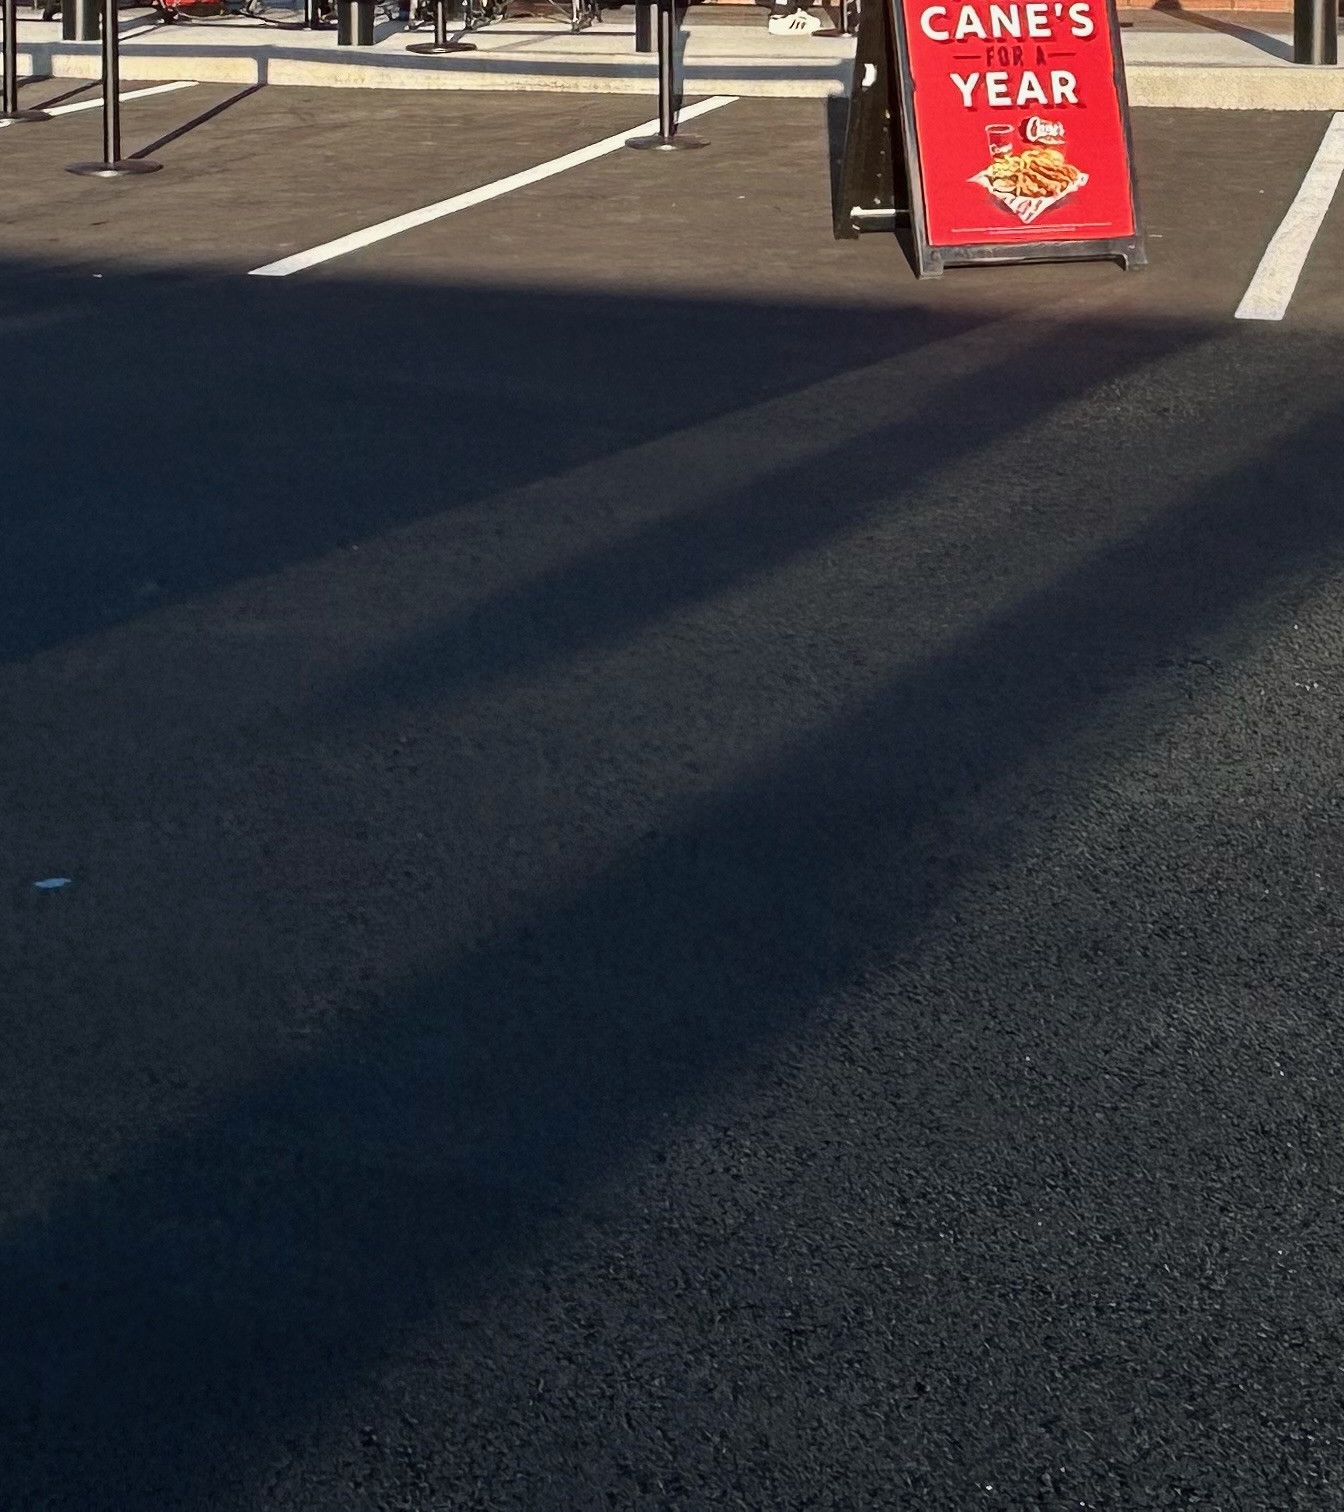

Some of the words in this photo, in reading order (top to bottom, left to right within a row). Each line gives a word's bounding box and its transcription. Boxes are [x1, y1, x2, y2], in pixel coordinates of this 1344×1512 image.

[920, 2, 1094, 40] CANE'S
[986, 45, 1024, 67] FOR
[1036, 45, 1047, 66] A
[950, 70, 1079, 108] YEAR
